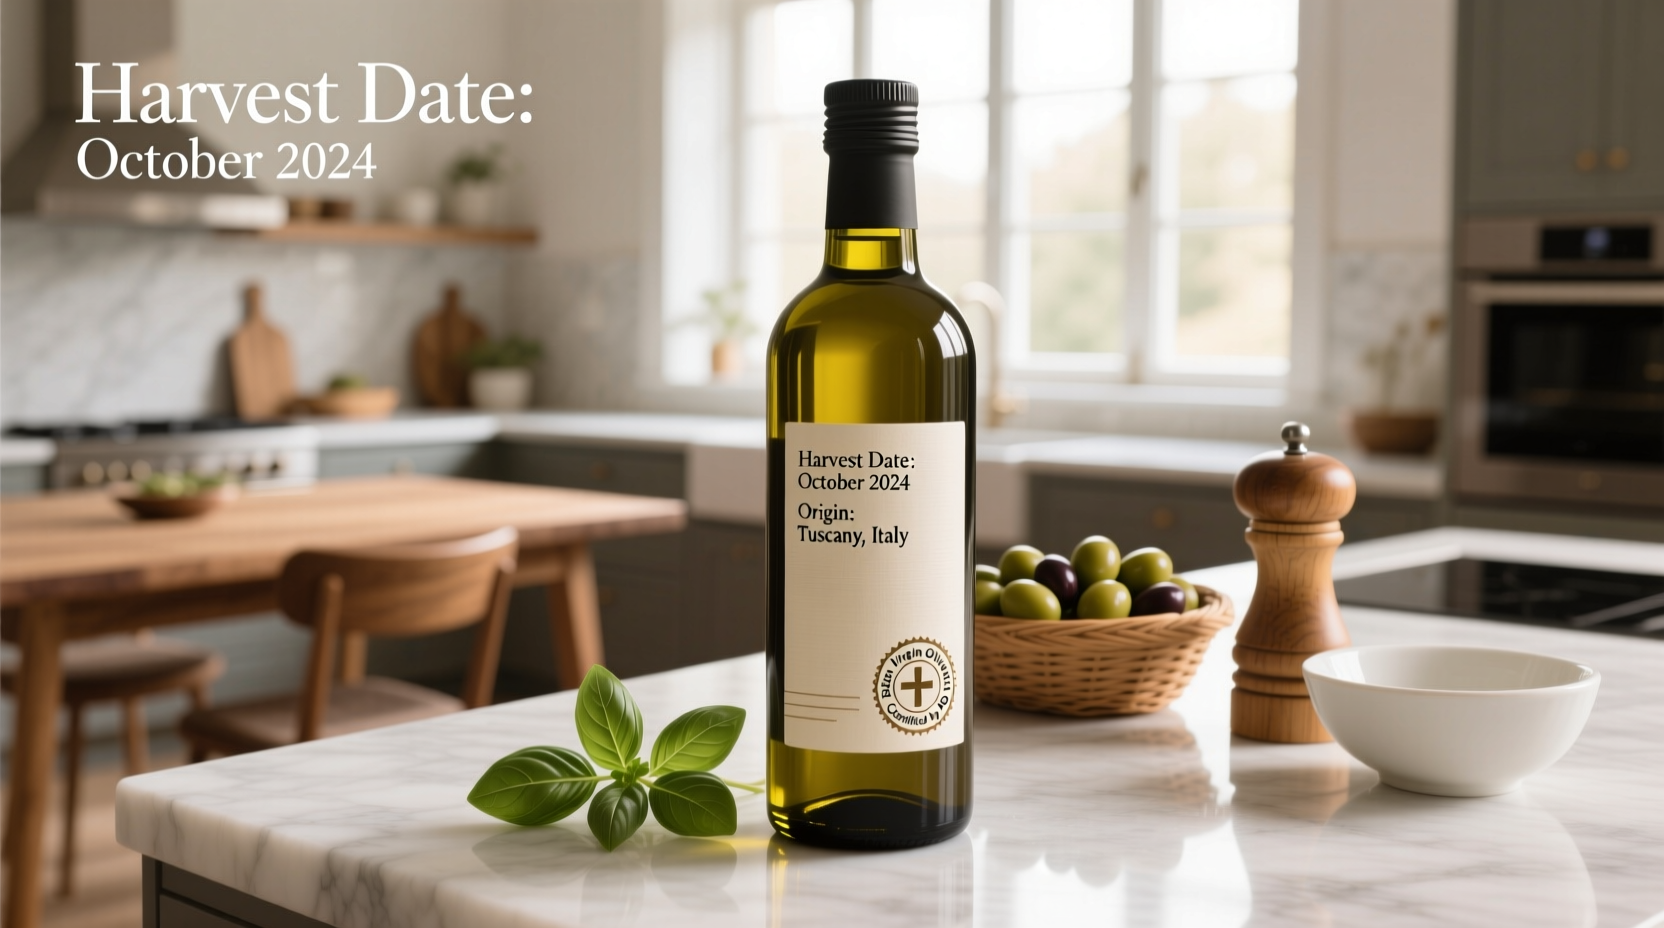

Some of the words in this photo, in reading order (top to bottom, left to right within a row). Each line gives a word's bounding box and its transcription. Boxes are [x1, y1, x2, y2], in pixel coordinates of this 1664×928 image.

[798, 450, 864, 468] Harvest
[868, 451, 915, 469] Date:
[798, 472, 865, 490] October
[869, 474, 911, 491] 2024
[798, 502, 855, 525] Origin:
[797, 524, 866, 548] Tuscany,
[872, 526, 909, 548] Italy
